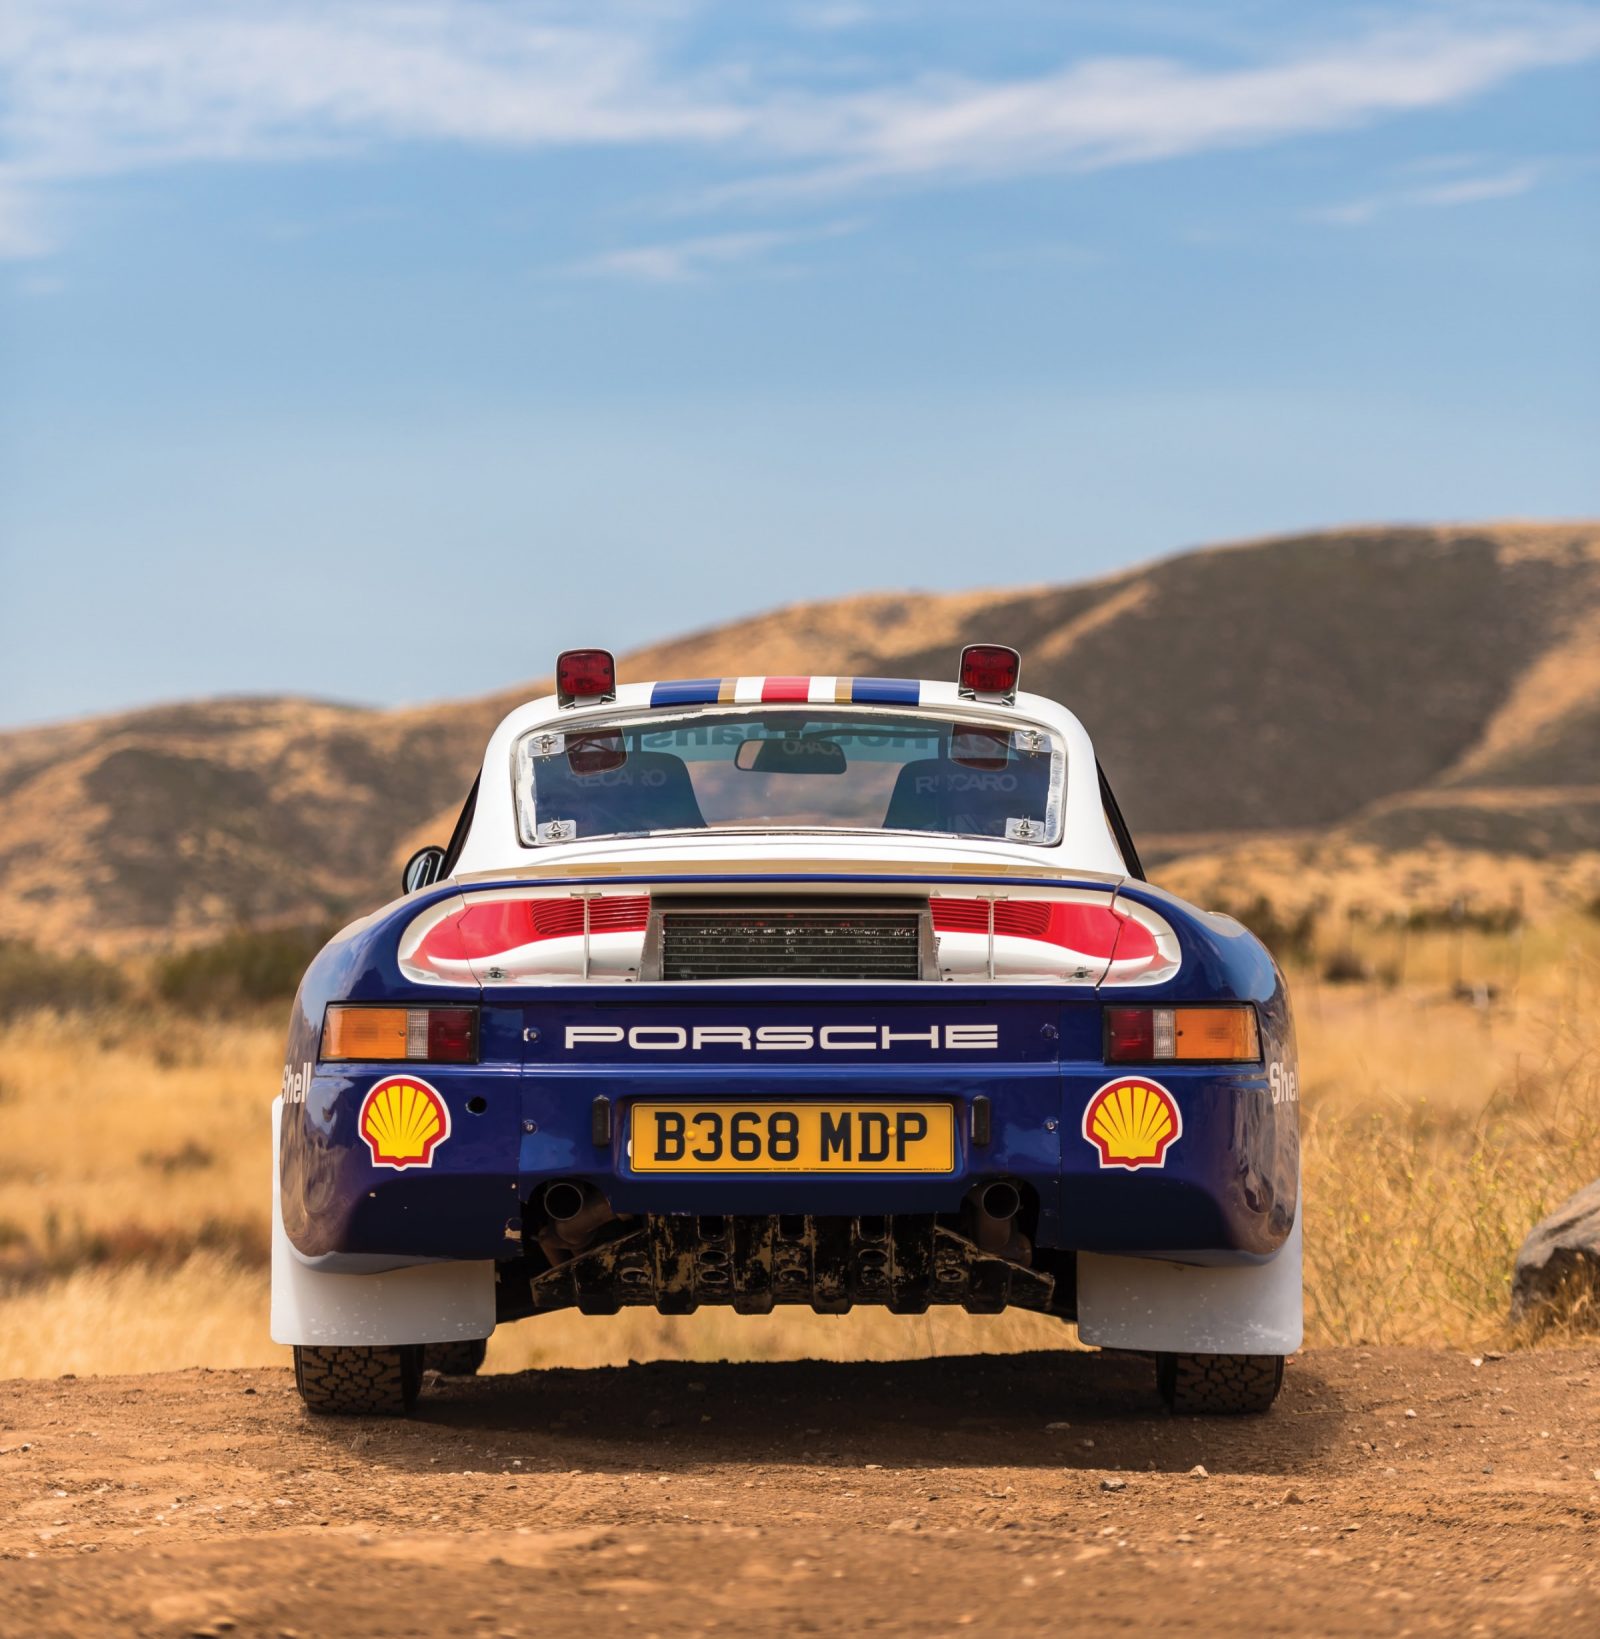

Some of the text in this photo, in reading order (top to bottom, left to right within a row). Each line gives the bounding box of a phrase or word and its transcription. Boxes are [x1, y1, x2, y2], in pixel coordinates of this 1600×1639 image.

[565, 1025, 998, 1050] PORSCHE
[281, 1062, 312, 1104] Shell
[1269, 1061, 1299, 1105] Shel
[654, 1111, 928, 1162] B368 MDP
